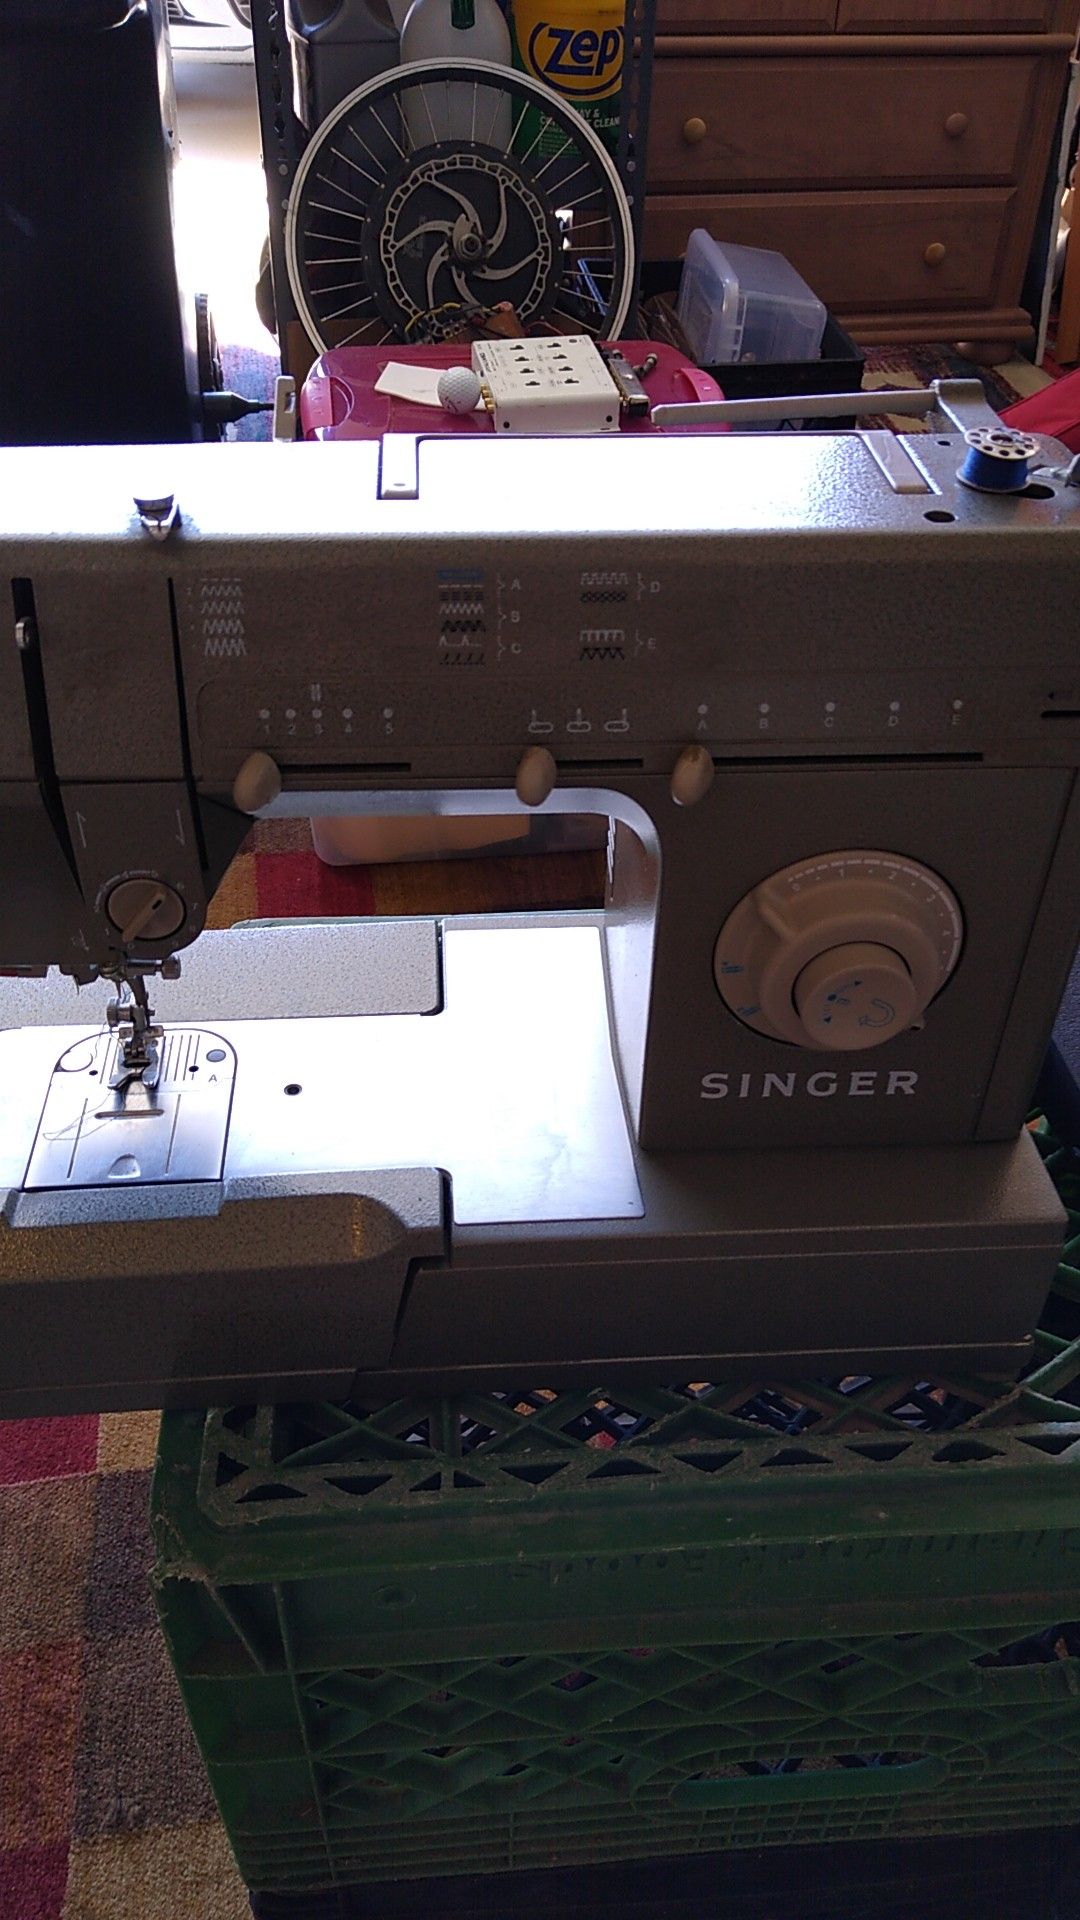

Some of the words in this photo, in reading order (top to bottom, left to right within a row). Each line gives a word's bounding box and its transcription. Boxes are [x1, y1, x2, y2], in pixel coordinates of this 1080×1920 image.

[510, 579, 521, 591] A
[650, 581, 660, 593] D
[510, 642, 521, 654] C
[759, 717, 769, 729] B
[208, 1073, 217, 1083] A
[699, 1070, 919, 1099] SINGER
